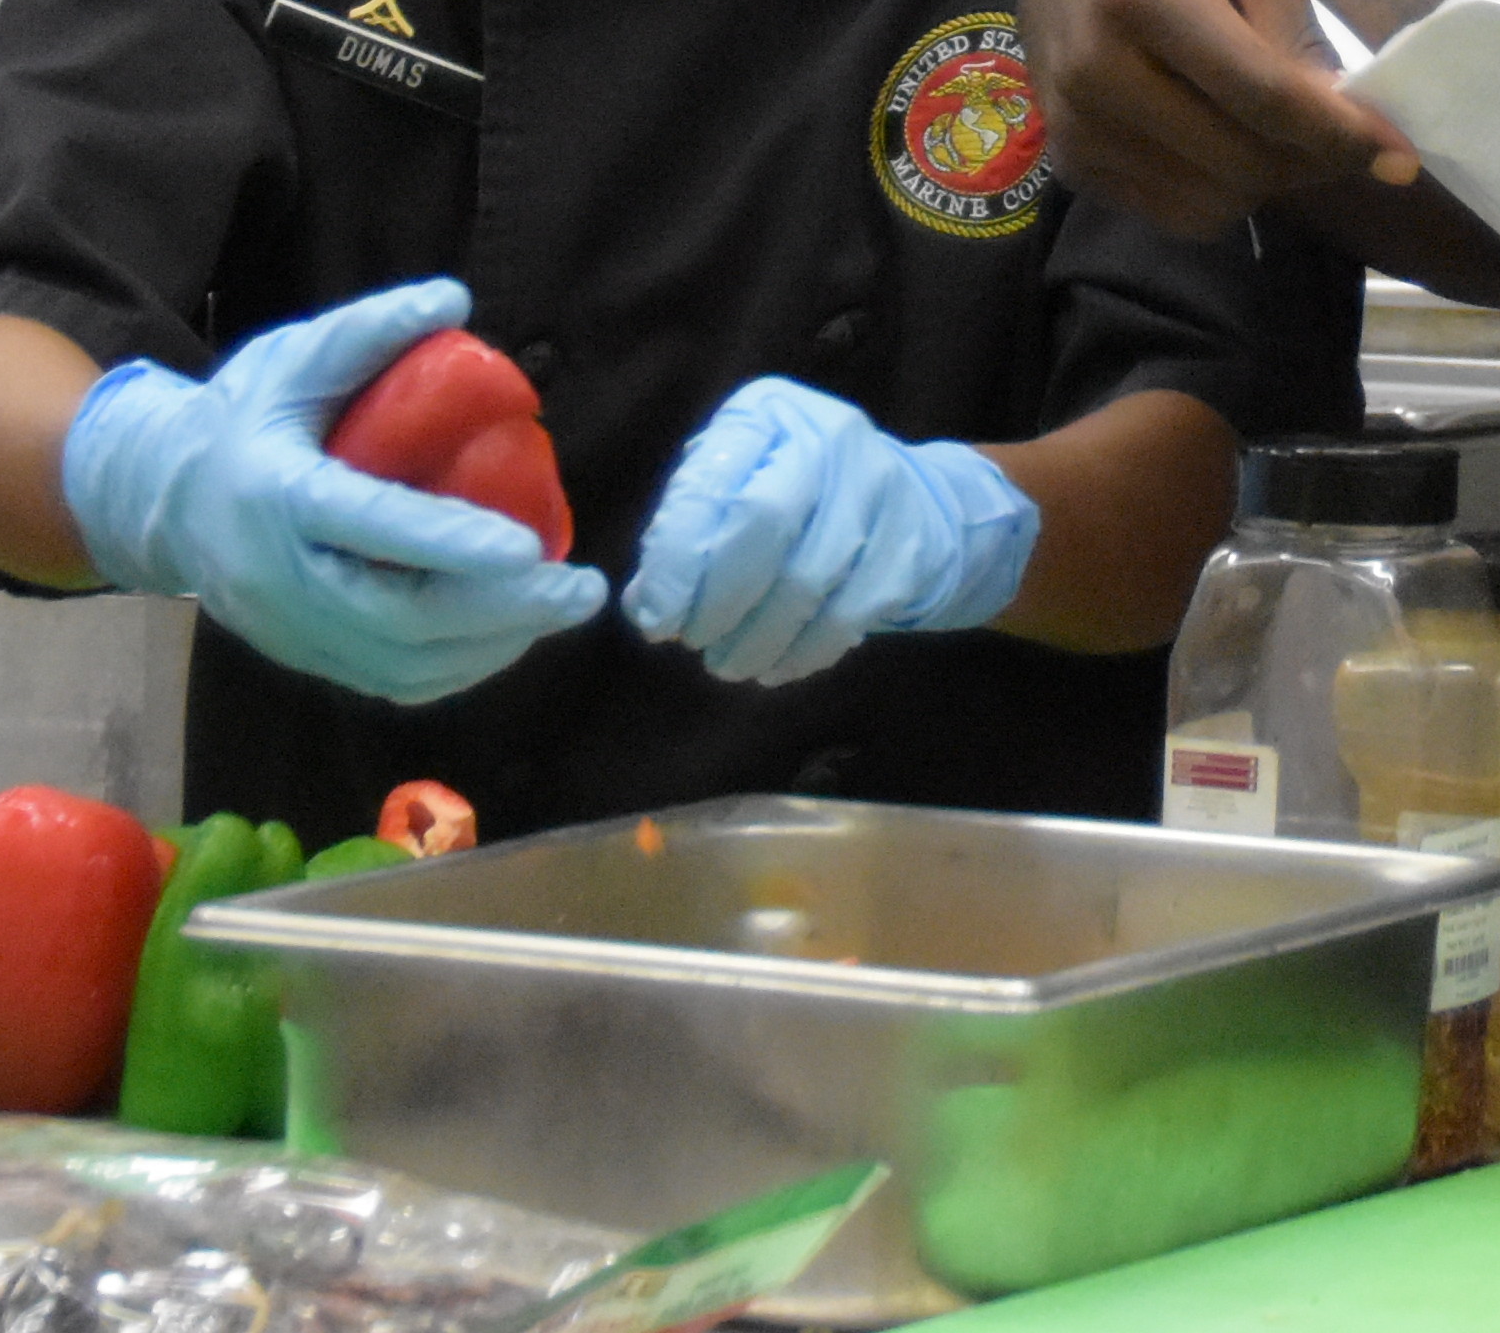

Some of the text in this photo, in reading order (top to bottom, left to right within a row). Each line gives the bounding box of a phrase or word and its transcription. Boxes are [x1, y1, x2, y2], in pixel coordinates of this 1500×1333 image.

[336, 36, 427, 88] DUMAS
[887, 30, 1026, 114] UNITED STA
[891, 152, 1053, 219] MARINE CORP
